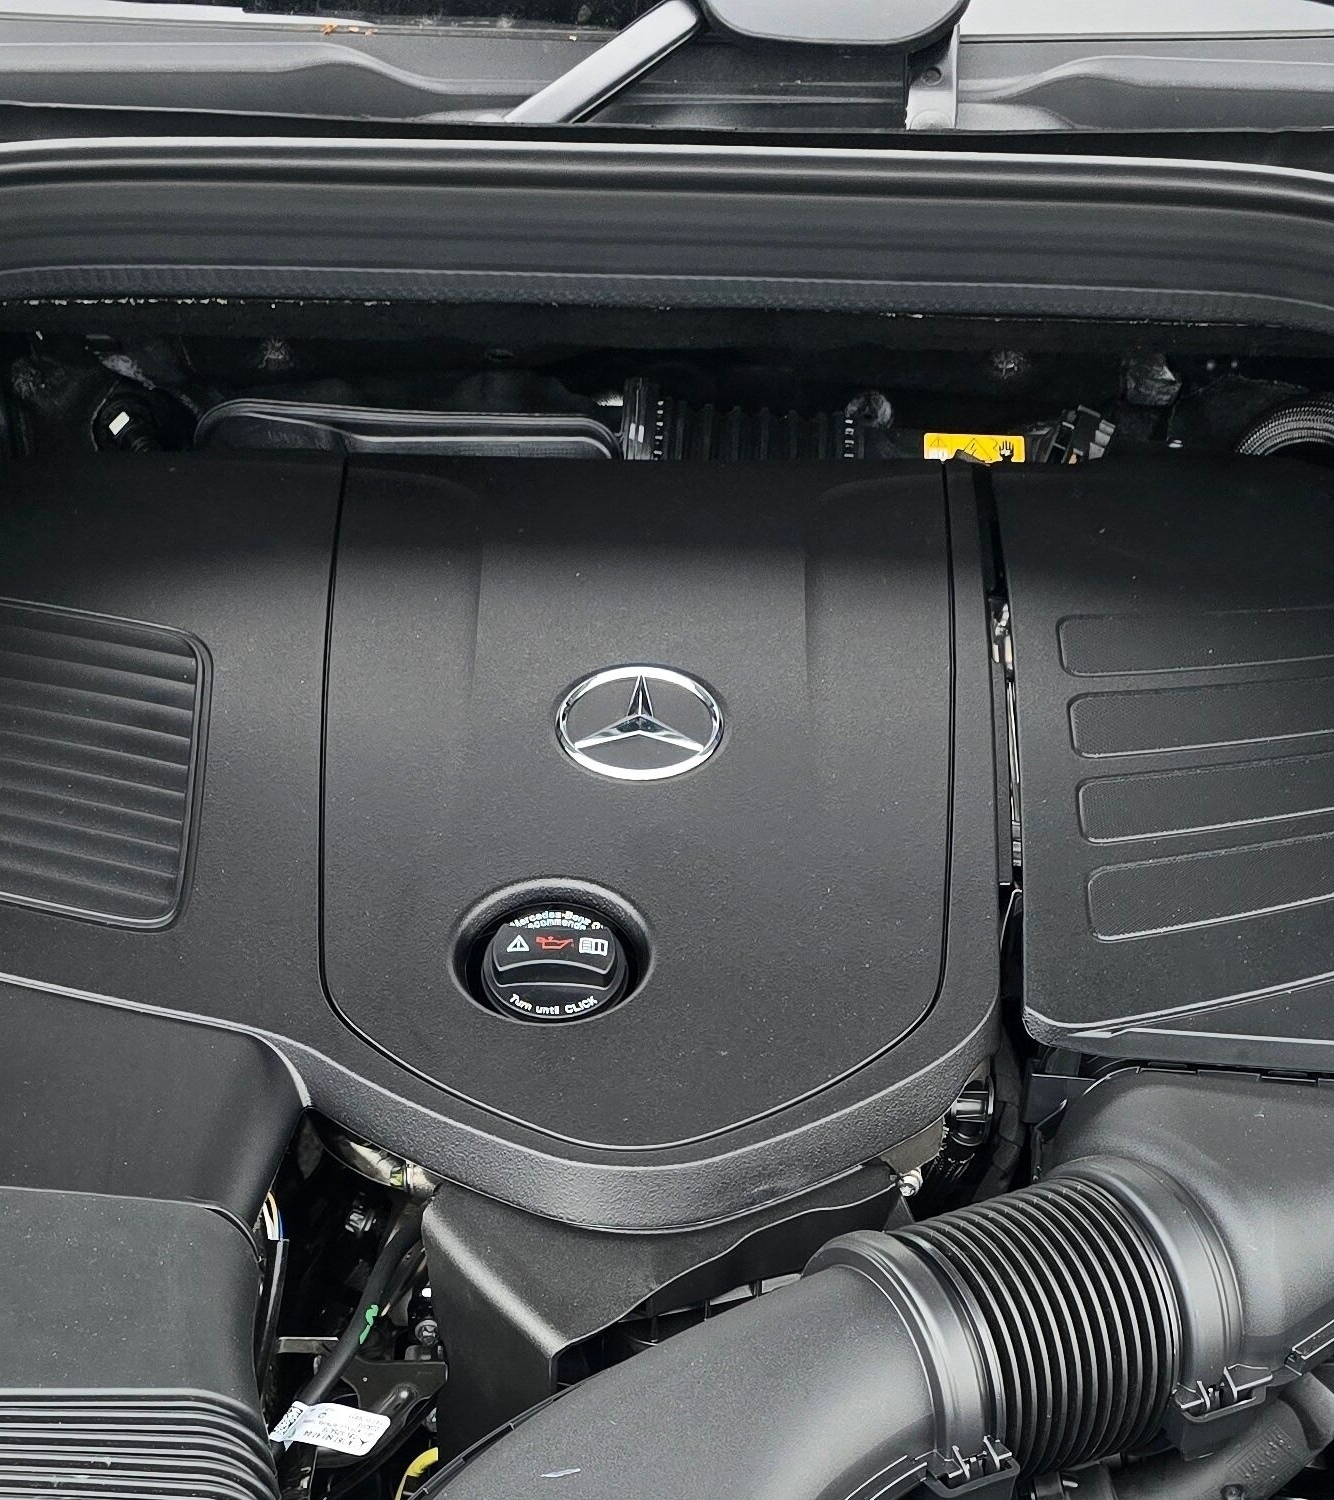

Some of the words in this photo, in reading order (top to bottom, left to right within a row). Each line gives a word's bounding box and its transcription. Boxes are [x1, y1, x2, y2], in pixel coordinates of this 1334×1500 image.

[509, 993, 532, 1010] Turn
[535, 1005, 559, 1014] until
[564, 995, 598, 1013] CLICK
